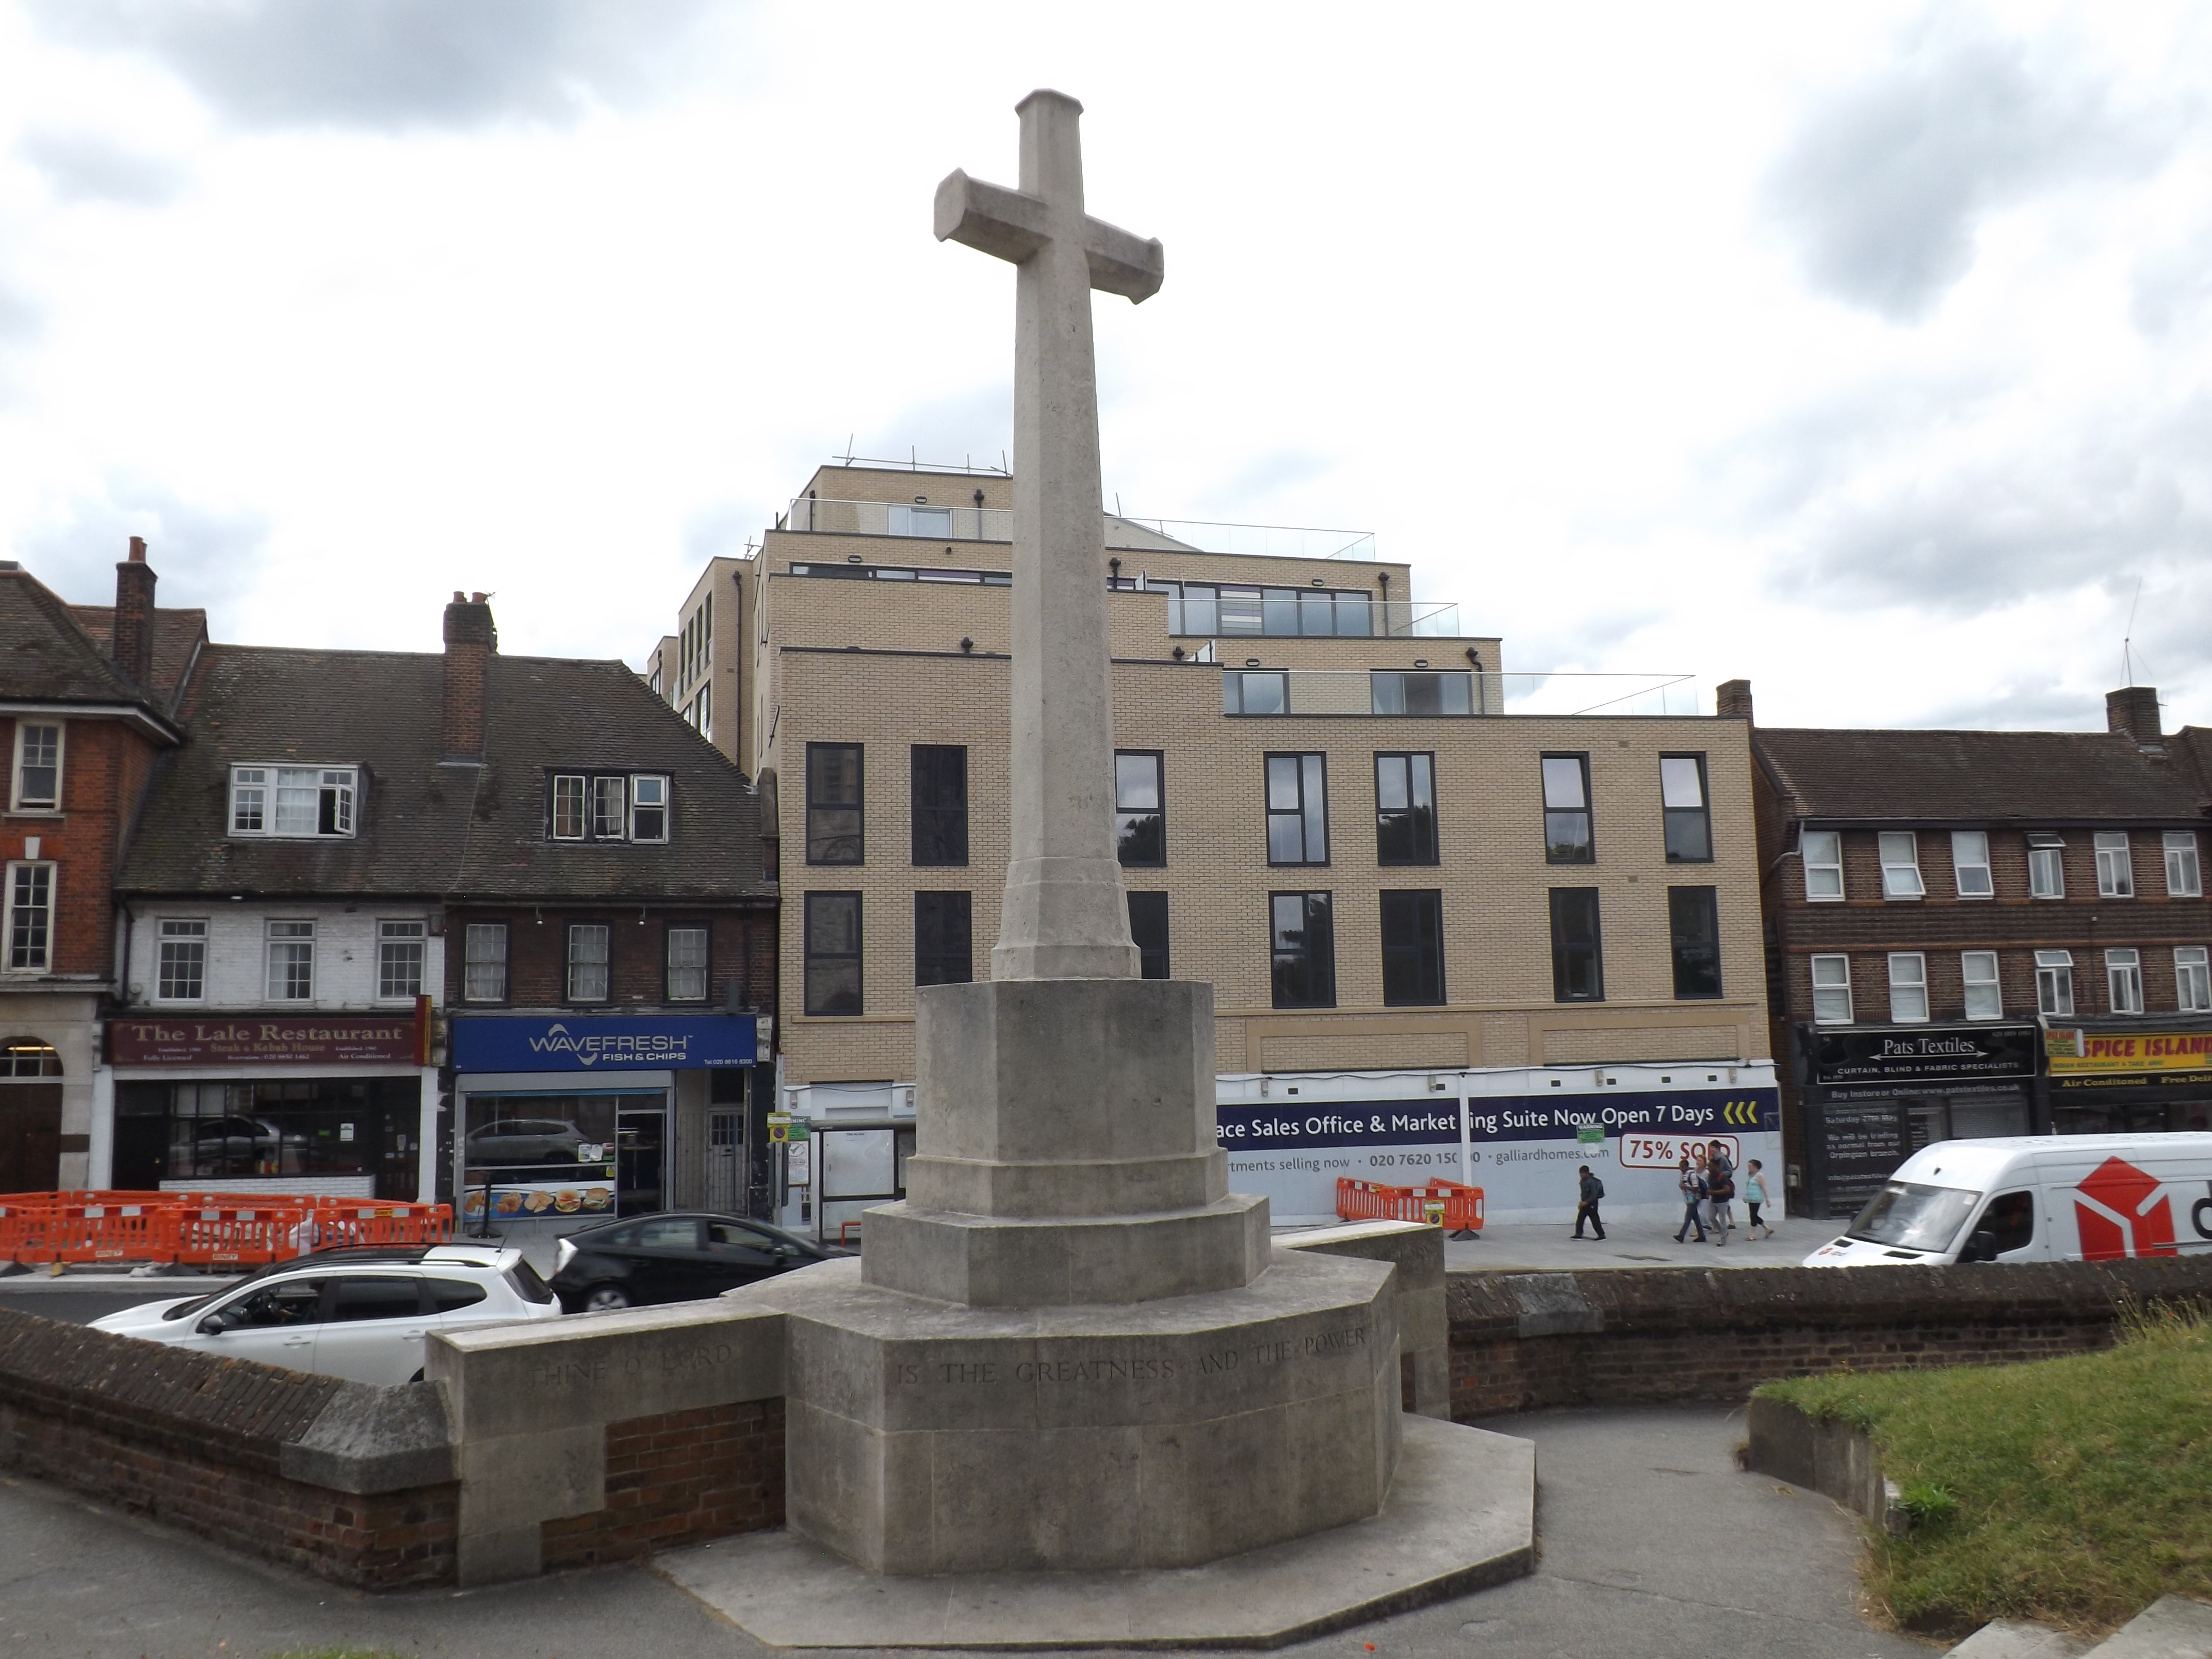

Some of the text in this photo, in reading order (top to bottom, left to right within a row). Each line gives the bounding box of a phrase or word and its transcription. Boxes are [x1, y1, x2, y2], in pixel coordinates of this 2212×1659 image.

[132, 1023, 402, 1041] The Lale Restaurant
[209, 1043, 241, 1052] Steak
[253, 1043, 288, 1052] Kebab
[291, 1043, 326, 1052] House
[528, 1035, 687, 1052] WAVEFRESH
[1884, 1036, 1975, 1054] Pats Textiles
[2084, 1036, 2212, 1057] SPICE ISLAND
[603, 1052, 687, 1061] FISH & CHIPS
[1960, 1062, 2019, 1070] SPECIALISTS
[1831, 1091, 1848, 1099] Buy
[1251, 1117, 1300, 1137] Sales
[1305, 1115, 1363, 1134] Office
[1370, 1115, 1387, 1132] &
[1502, 1110, 1548, 1128] Suite
[1554, 1109, 1597, 1126] Now
[1601, 1107, 1650, 1129] Open
[1655, 1105, 1667, 1123] 7
[1671, 1104, 1715, 1127] Days
[1630, 1140, 1673, 1160] 75%
[1228, 1161, 1275, 1172] tments
[1279, 1157, 1320, 1172] selling
[1324, 1159, 1350, 1168] now
[1370, 1154, 1395, 1167] 020
[1398, 1153, 1432, 1165] 7620
[897, 1327, 1366, 1385] IS THE GREATNESS AND THE POWER
[527, 1344, 732, 1388] THINE O LORD
